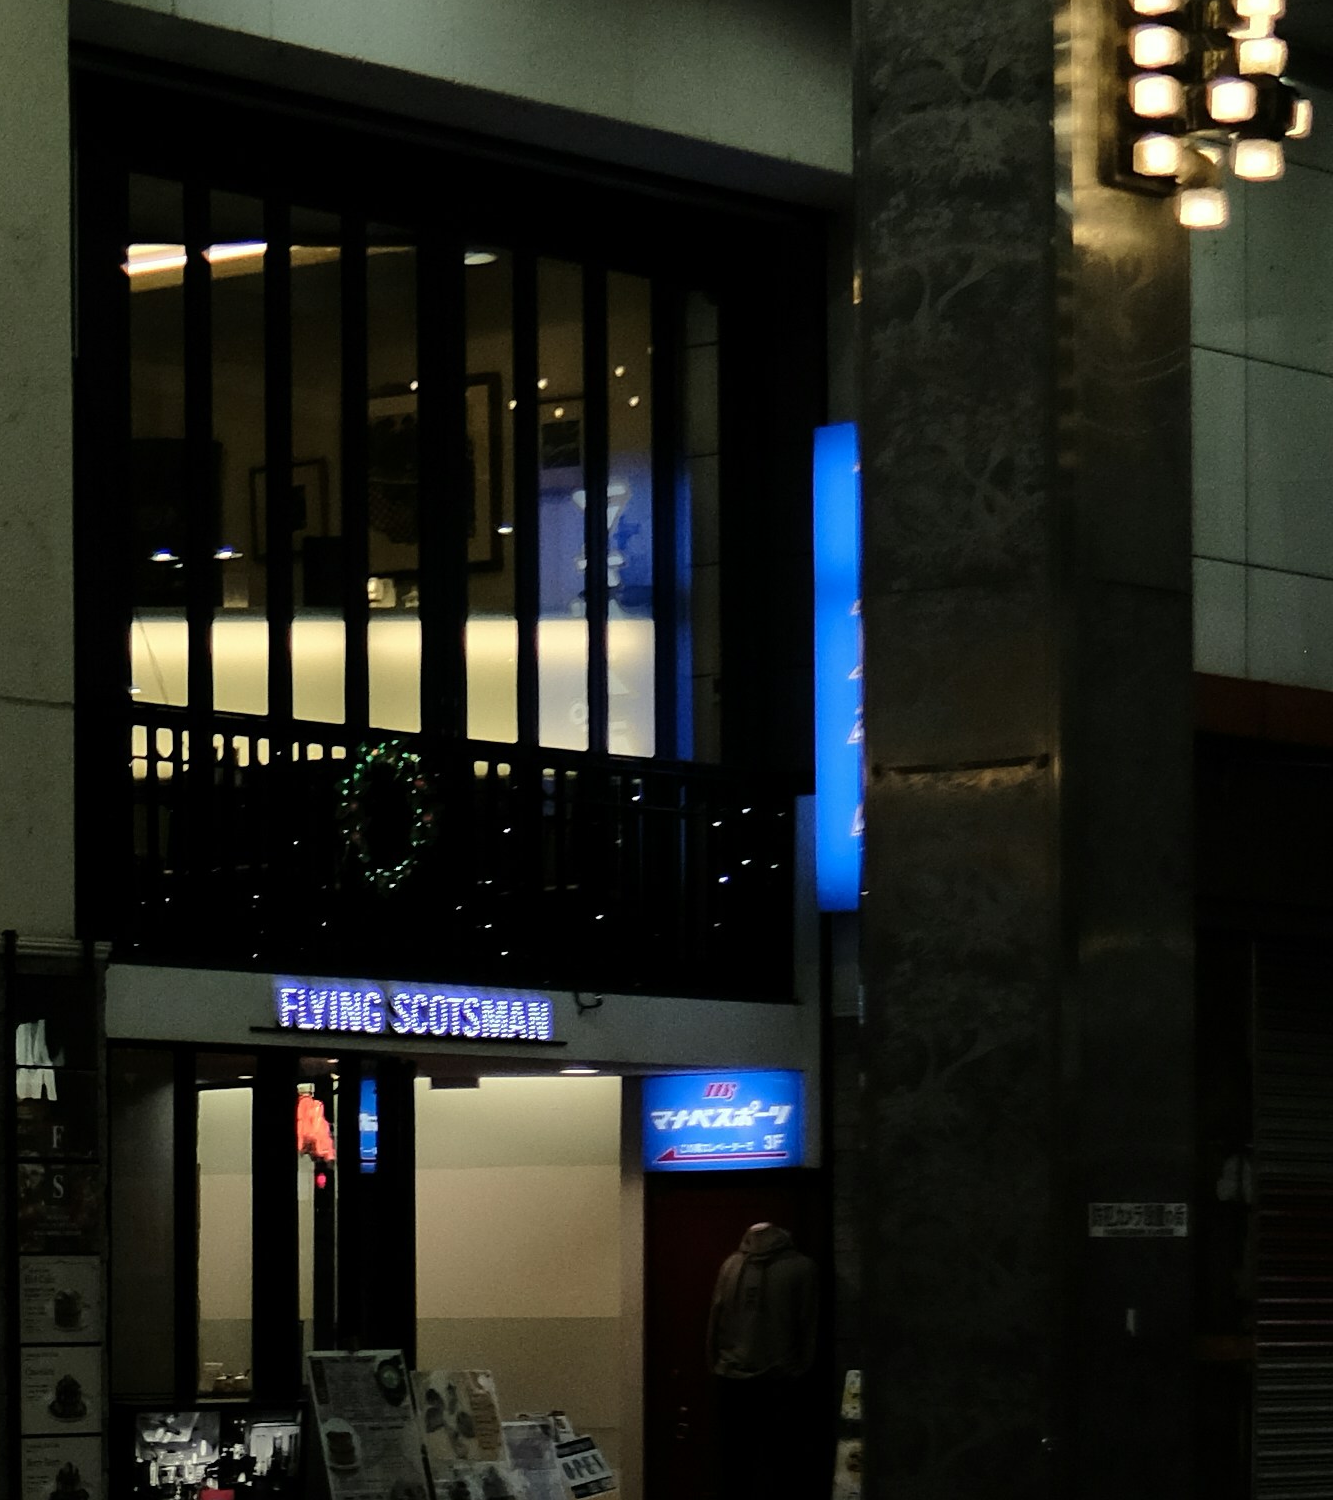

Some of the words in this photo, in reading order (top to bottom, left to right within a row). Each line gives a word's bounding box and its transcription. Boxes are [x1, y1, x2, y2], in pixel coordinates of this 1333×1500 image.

[280, 988, 382, 1034] FLYING
[390, 992, 550, 1041] SCOTSMAN
[763, 1133, 785, 1150] 3F
